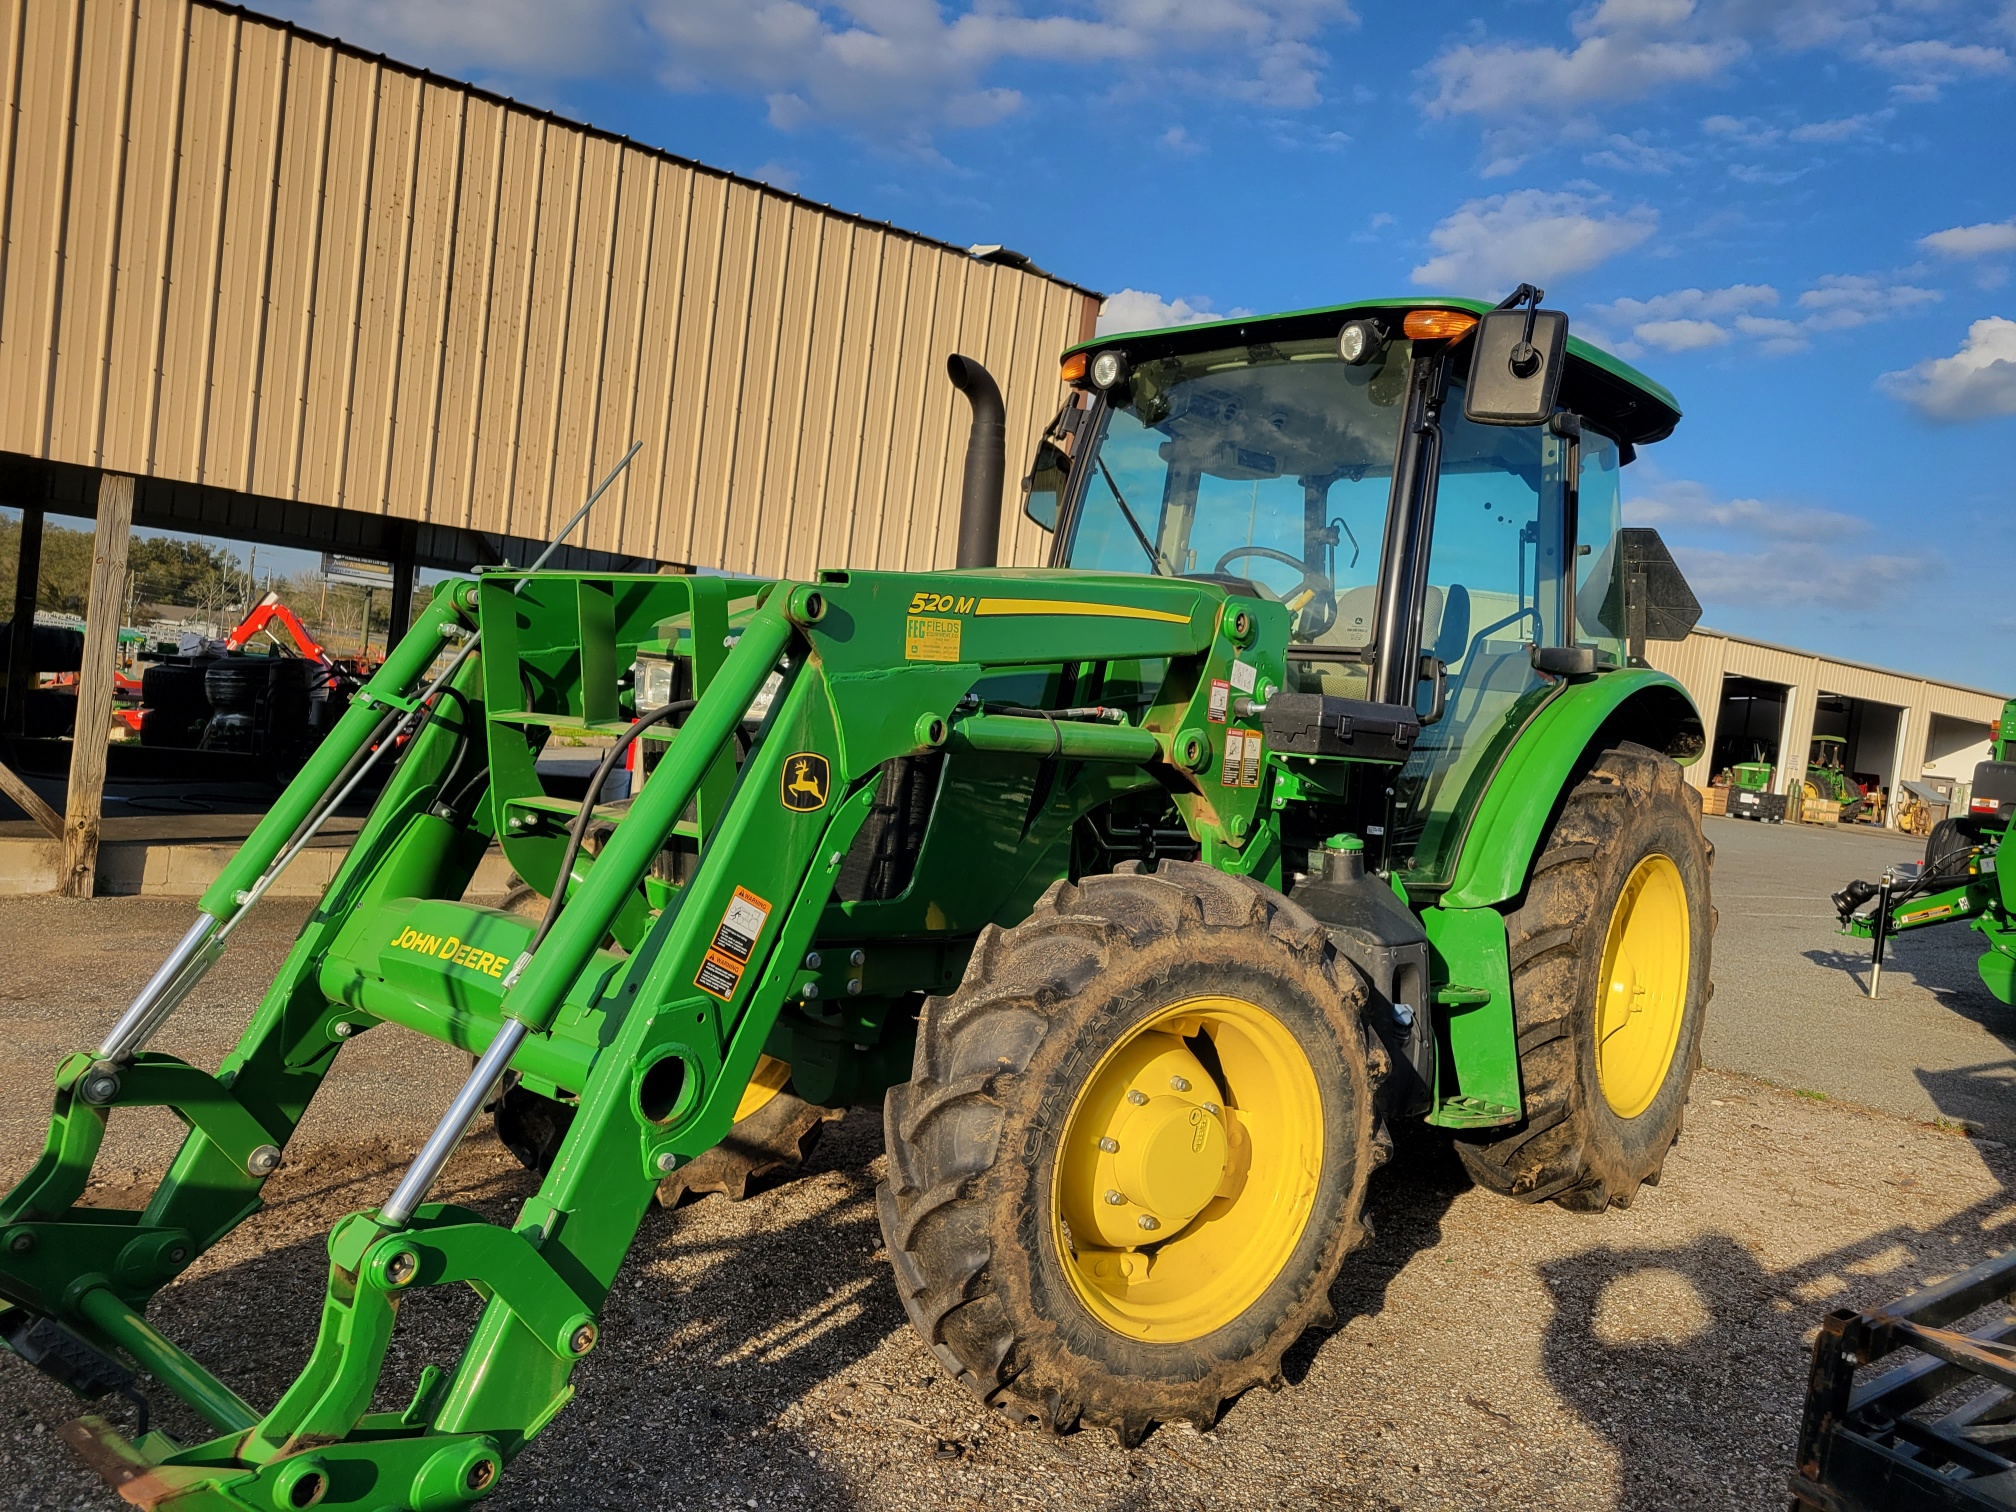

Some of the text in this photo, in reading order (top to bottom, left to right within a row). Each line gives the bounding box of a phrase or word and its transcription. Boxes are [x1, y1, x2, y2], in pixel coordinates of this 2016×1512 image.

[908, 620, 926, 638] FEC
[926, 620, 959, 633] FIELDS
[744, 892, 767, 910] WARNING
[390, 925, 510, 979] JOHN DEERE
[716, 958, 740, 973] WARNING
